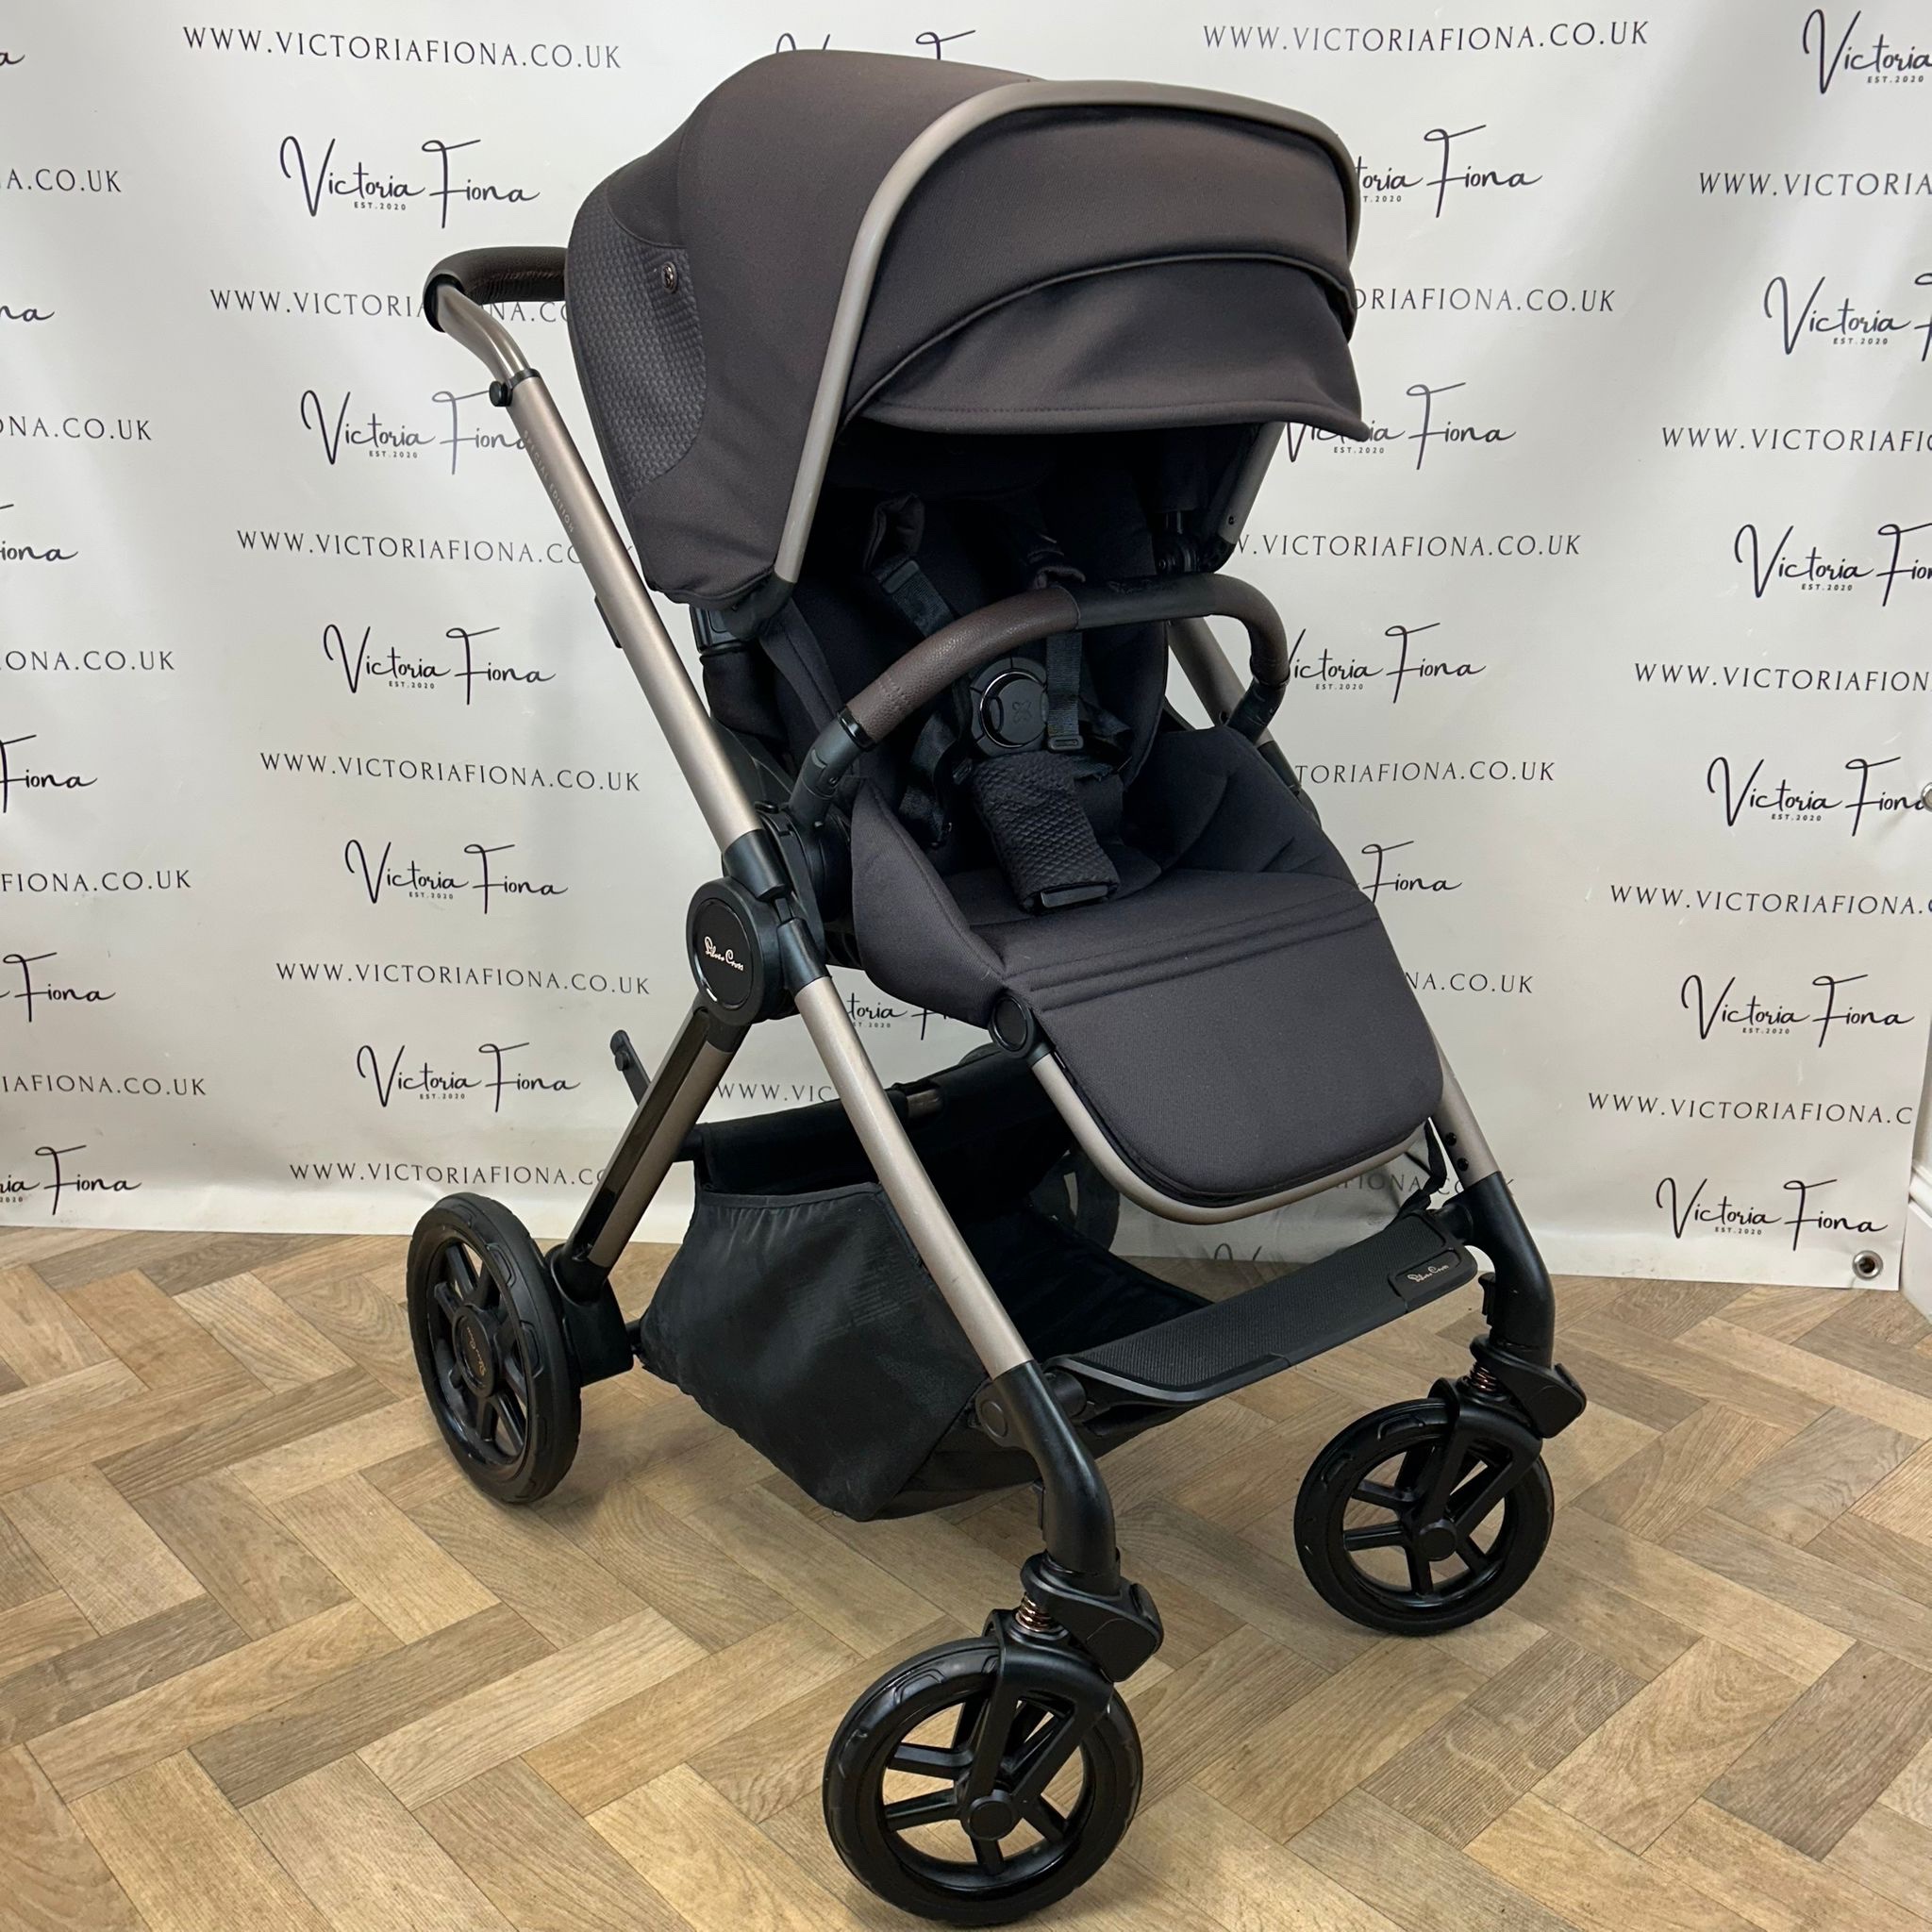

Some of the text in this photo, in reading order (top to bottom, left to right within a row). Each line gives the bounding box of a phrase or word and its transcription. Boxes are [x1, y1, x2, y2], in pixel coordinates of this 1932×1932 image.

[183, 26, 621, 68] WWW.VICTORIAFIONA.CO.UK
[1204, 21, 1649, 52] WWW.VICTORIAFIONA.CO.UK
[279, 136, 541, 229] Victoria Fiona
[1355, 125, 1543, 219] toria Fiona
[1763, 275, 1912, 355] Victoria
[300, 390, 437, 465] Victoria
[1407, 382, 1517, 471] Fiona
[1734, 524, 1874, 598] Victoria
[323, 624, 557, 706] Victoria Fiona
[1384, 623, 1487, 704] Fiona
[1635, 663, 1932, 691] WWW.VICTORIAFION
[260, 753, 640, 791] WWW.VICTORIAFIONA.CO.UK
[1707, 757, 1843, 827] Victoria
[344, 840, 568, 914] Victoria Fiona
[1361, 840, 1462, 903] Fiona
[3, 952, 116, 1023] Fiona
[276, 963, 649, 995] WWW.VICTORIAFIONA.CO.UK
[1681, 974, 1915, 1048] Victoria Fiona
[357, 1042, 580, 1113] Victoria Fiona
[35, 1145, 142, 1216] Fiona
[1656, 1177, 1888, 1251] Victoria Fiona
